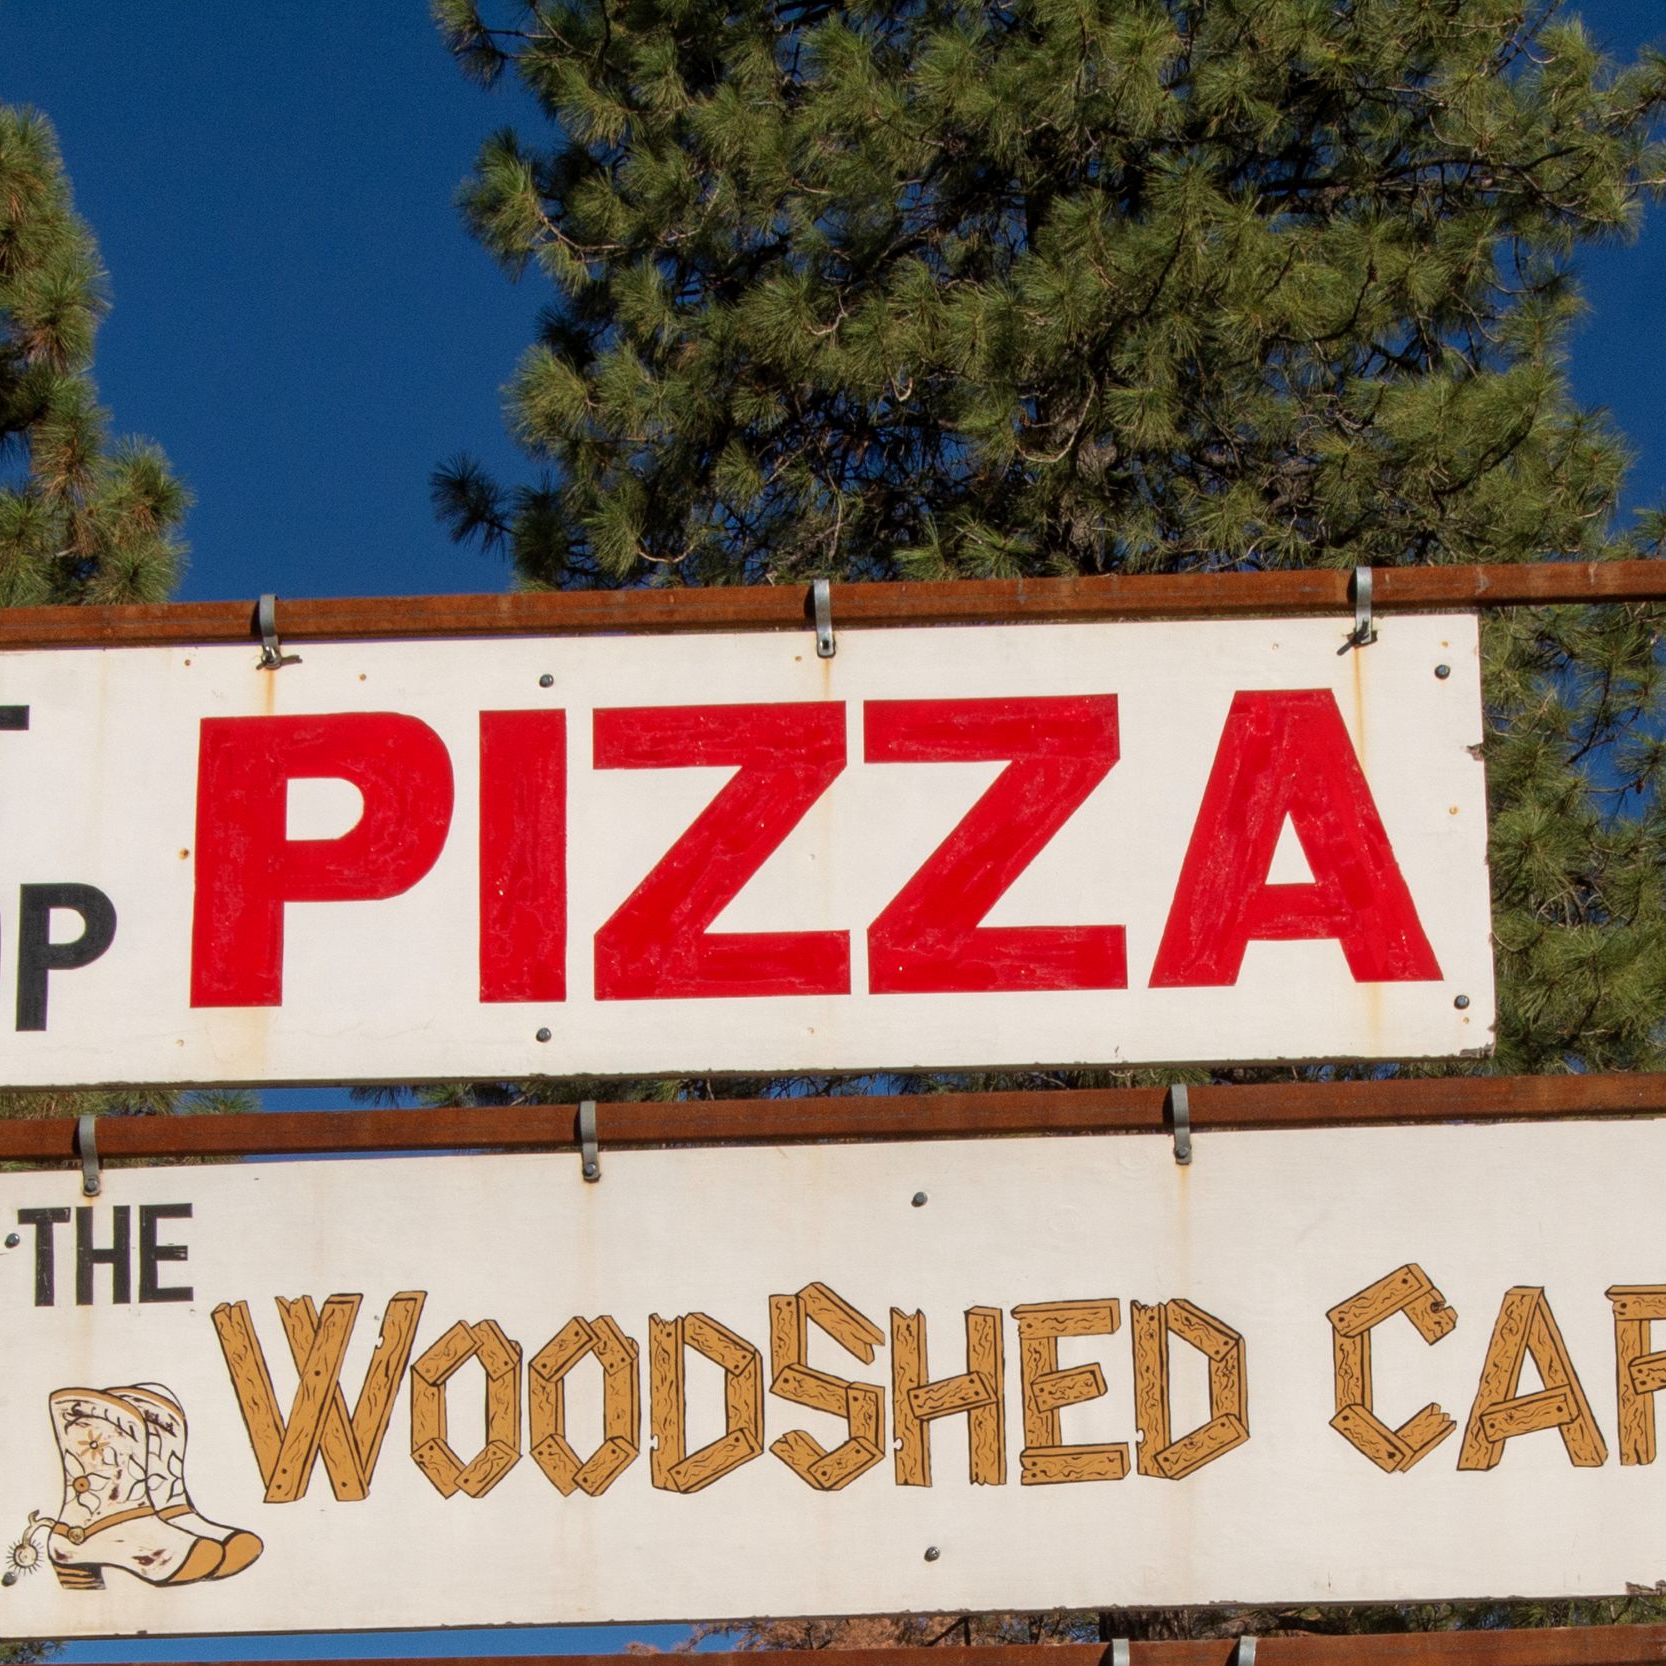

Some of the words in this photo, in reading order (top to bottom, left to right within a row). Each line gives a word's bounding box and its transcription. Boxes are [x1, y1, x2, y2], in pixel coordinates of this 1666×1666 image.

[190, 689, 1442, 1007] PIZZA
[18, 1204, 192, 1306] THE
[211, 1282, 1249, 1503] WOODSHED
